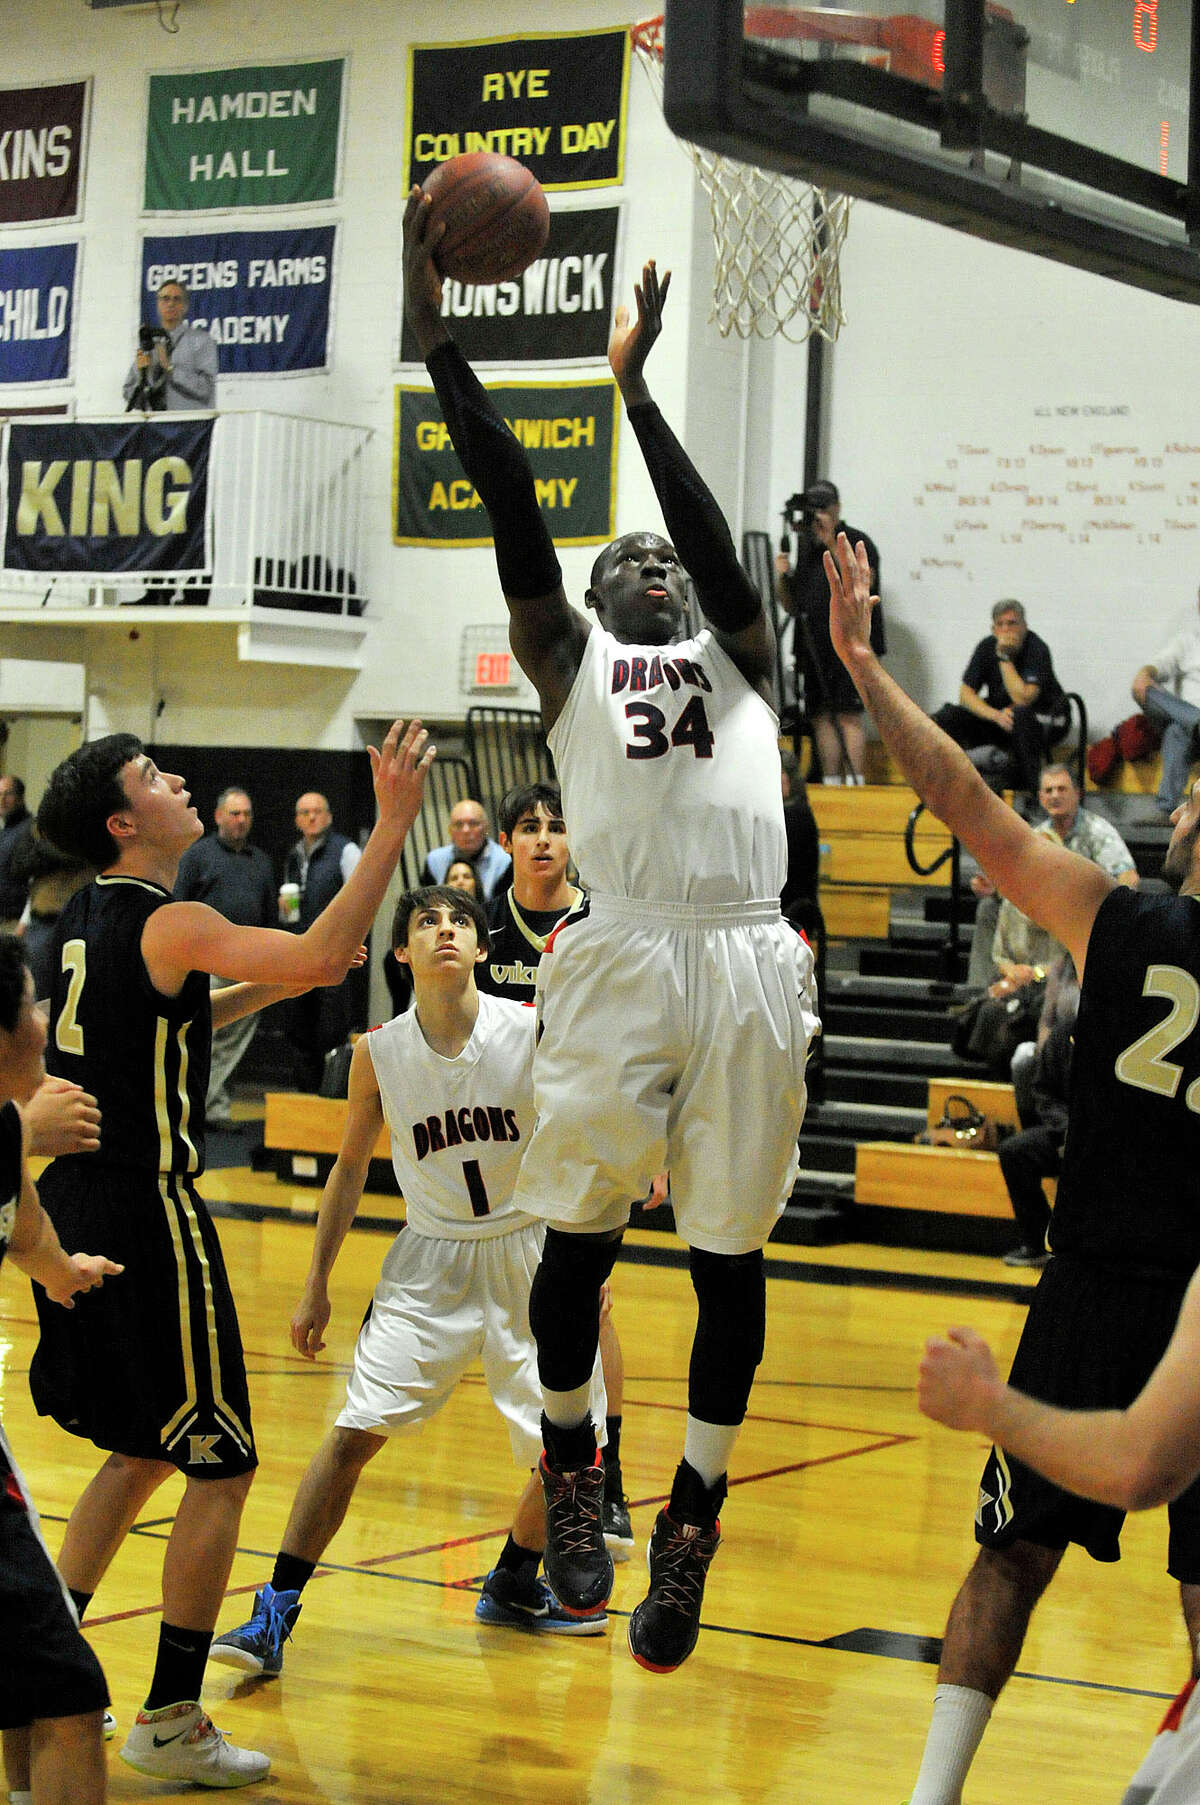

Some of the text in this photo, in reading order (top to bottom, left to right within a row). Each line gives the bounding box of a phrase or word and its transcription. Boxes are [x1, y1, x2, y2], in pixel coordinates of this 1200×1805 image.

[171, 88, 317, 124] HAMDEN
[482, 69, 550, 102] RYE
[414, 119, 616, 162] COUNTRY DAY
[189, 149, 289, 182] HALL
[147, 256, 326, 292] GREENS FARMS
[16, 456, 192, 537] KING
[476, 653, 511, 685] EXIT
[624, 695, 715, 760] 34
[56, 939, 87, 1056] 2
[1115, 964, 1200, 1115] 2
[412, 1106, 520, 1162] DRAGONS
[462, 1159, 490, 1217] 1
[187, 1434, 223, 1465] K
